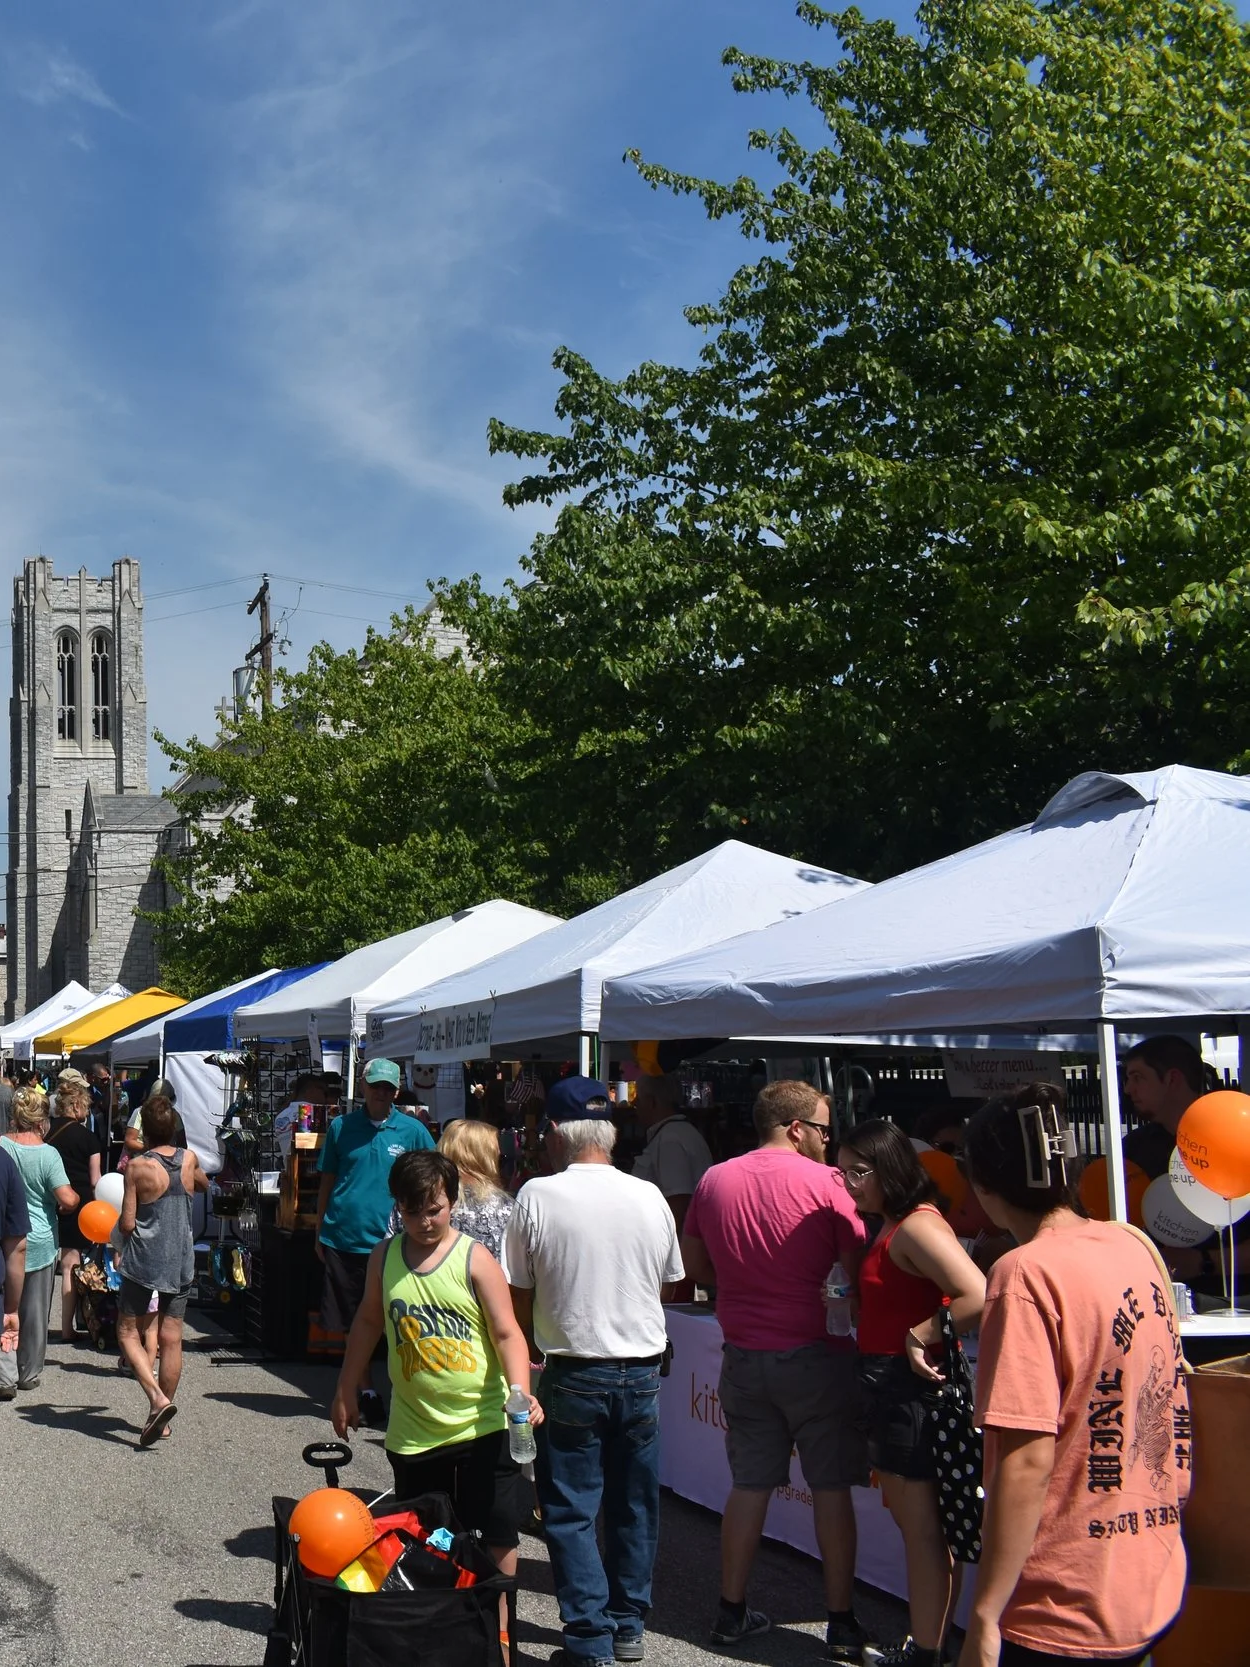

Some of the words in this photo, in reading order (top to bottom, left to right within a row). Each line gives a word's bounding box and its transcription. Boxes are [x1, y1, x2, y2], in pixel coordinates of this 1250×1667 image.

[1157, 1210, 1199, 1236] kitchen
[396, 1337, 478, 1382] VIBES
[1144, 1504, 1180, 1529] NIN
